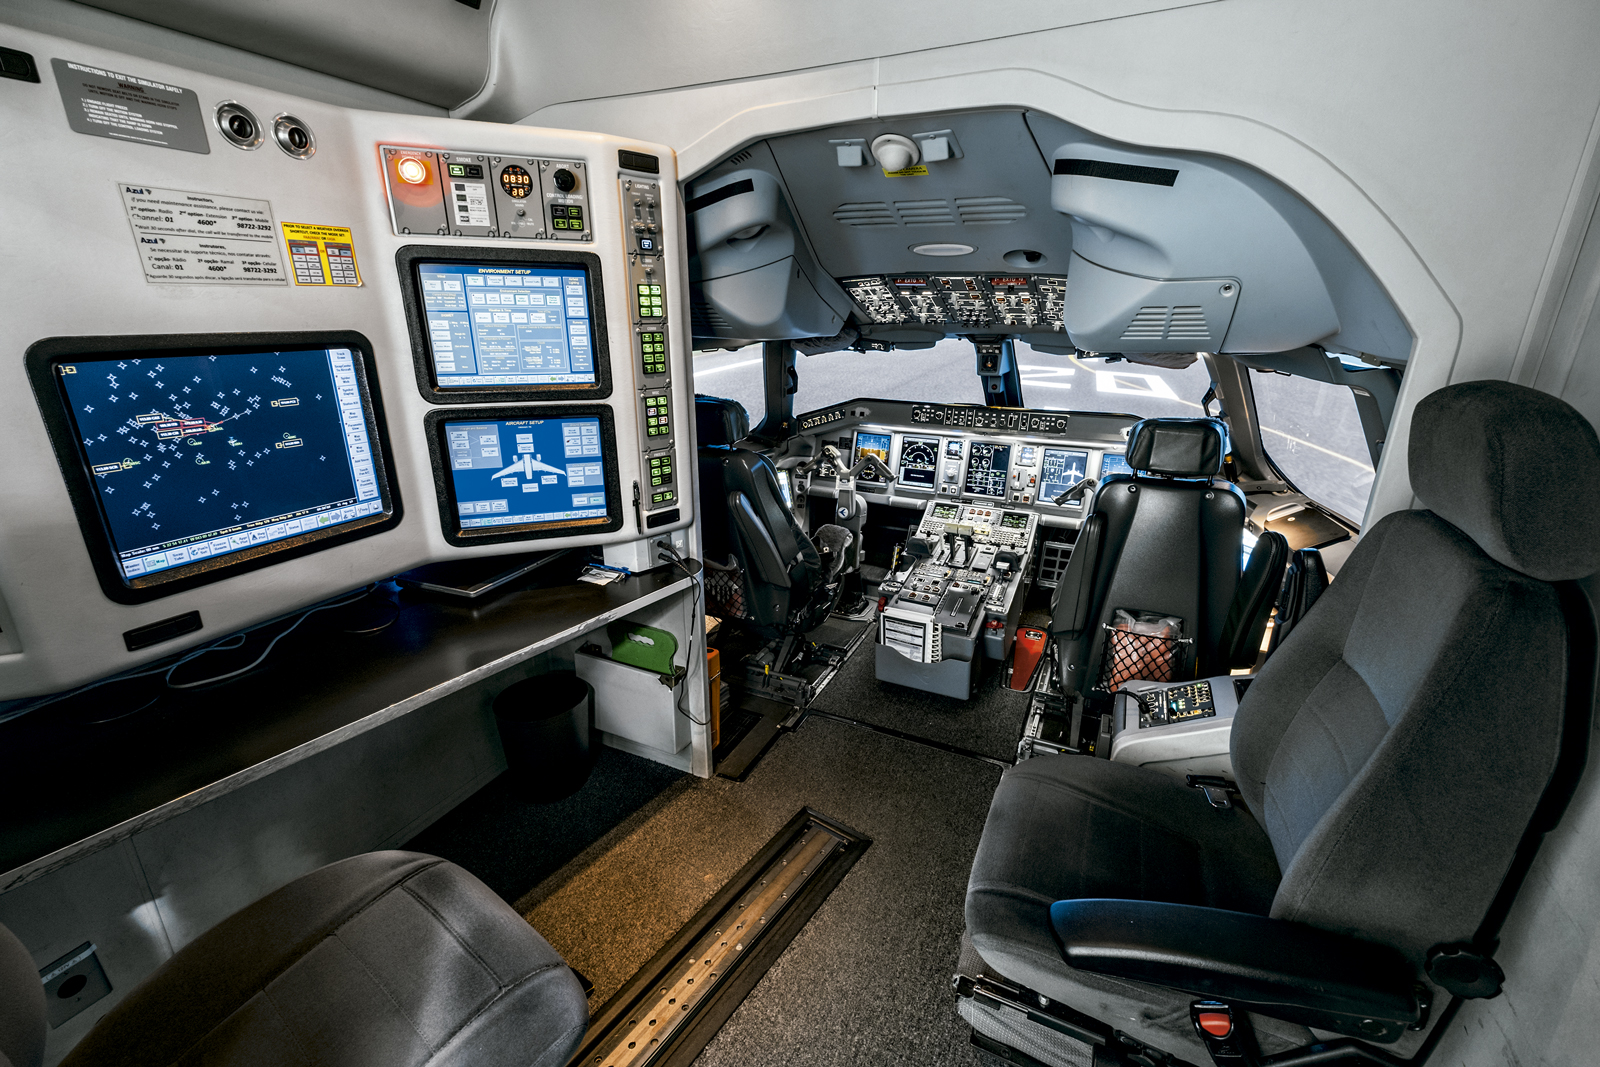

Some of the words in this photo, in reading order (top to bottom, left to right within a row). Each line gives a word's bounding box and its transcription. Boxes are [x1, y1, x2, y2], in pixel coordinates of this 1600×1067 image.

[67, 62, 107, 77] INSTRUCTIONS
[126, 76, 137, 84] THE
[137, 79, 165, 90] SIMULATOR
[166, 85, 183, 94] SAFELY
[117, 82, 145, 93] WARNING
[126, 186, 144, 195] Azul
[236, 222, 271, 231] 98722-3292
